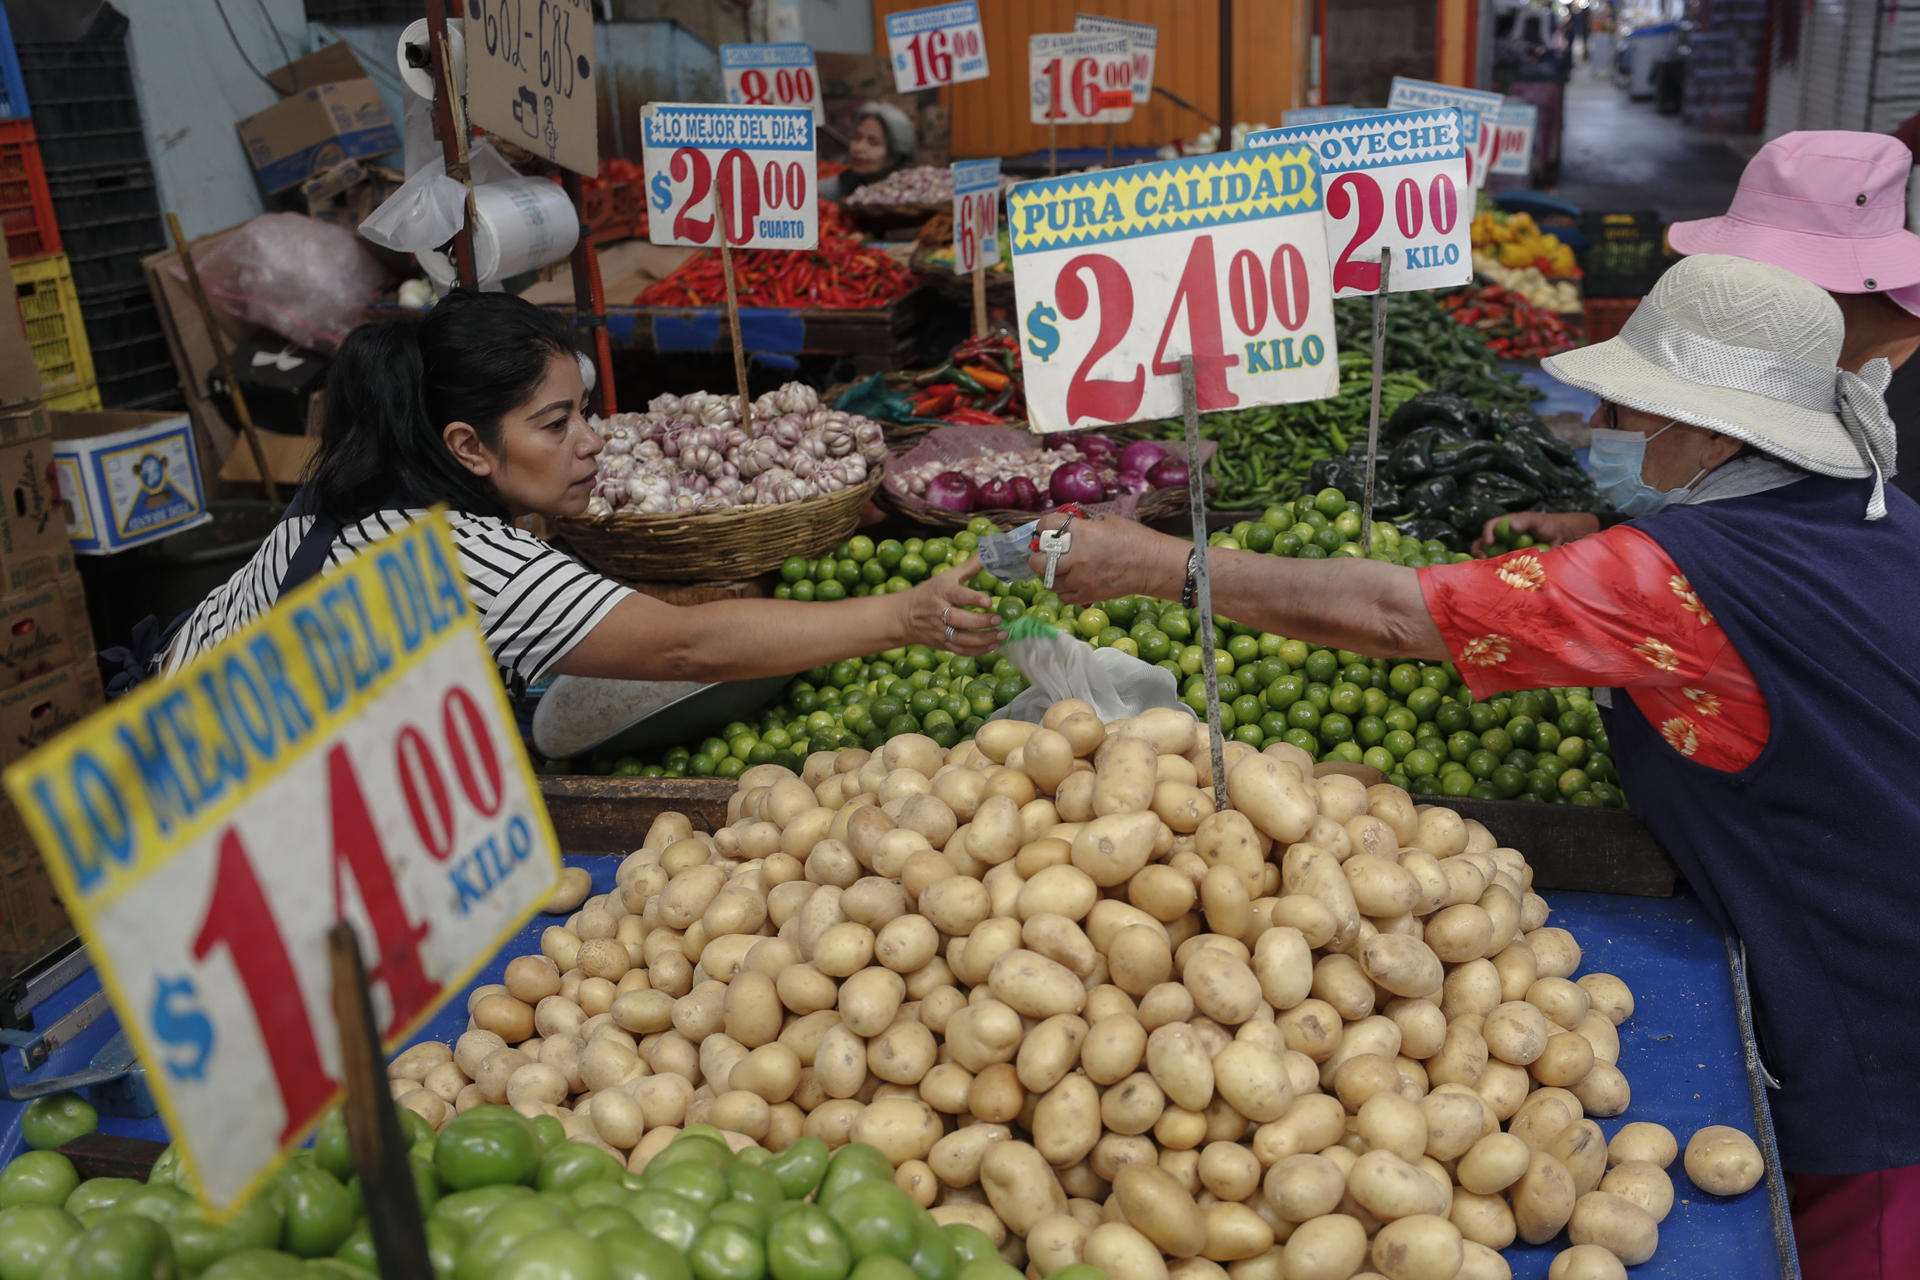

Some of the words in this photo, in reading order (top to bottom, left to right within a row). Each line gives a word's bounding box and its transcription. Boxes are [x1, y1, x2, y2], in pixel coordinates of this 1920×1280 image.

[664, 118, 681, 138] LO
[686, 119, 735, 139] MEJOR
[740, 120, 767, 139] DEL
[772, 120, 797, 140] DIA
[1320, 123, 1455, 159] OVECHE
[1023, 191, 1125, 235] PURA
[1134, 163, 1307, 217] CALIDAD
[759, 219, 805, 239] CUARTO
[1405, 243, 1460, 271] KILO
[1245, 334, 1324, 374] KILO
[33, 748, 135, 894] LO
[115, 634, 318, 839] MEJOR
[290, 577, 396, 714] DEL
[374, 526, 468, 655] DIA
[446, 813, 533, 917] KILO
